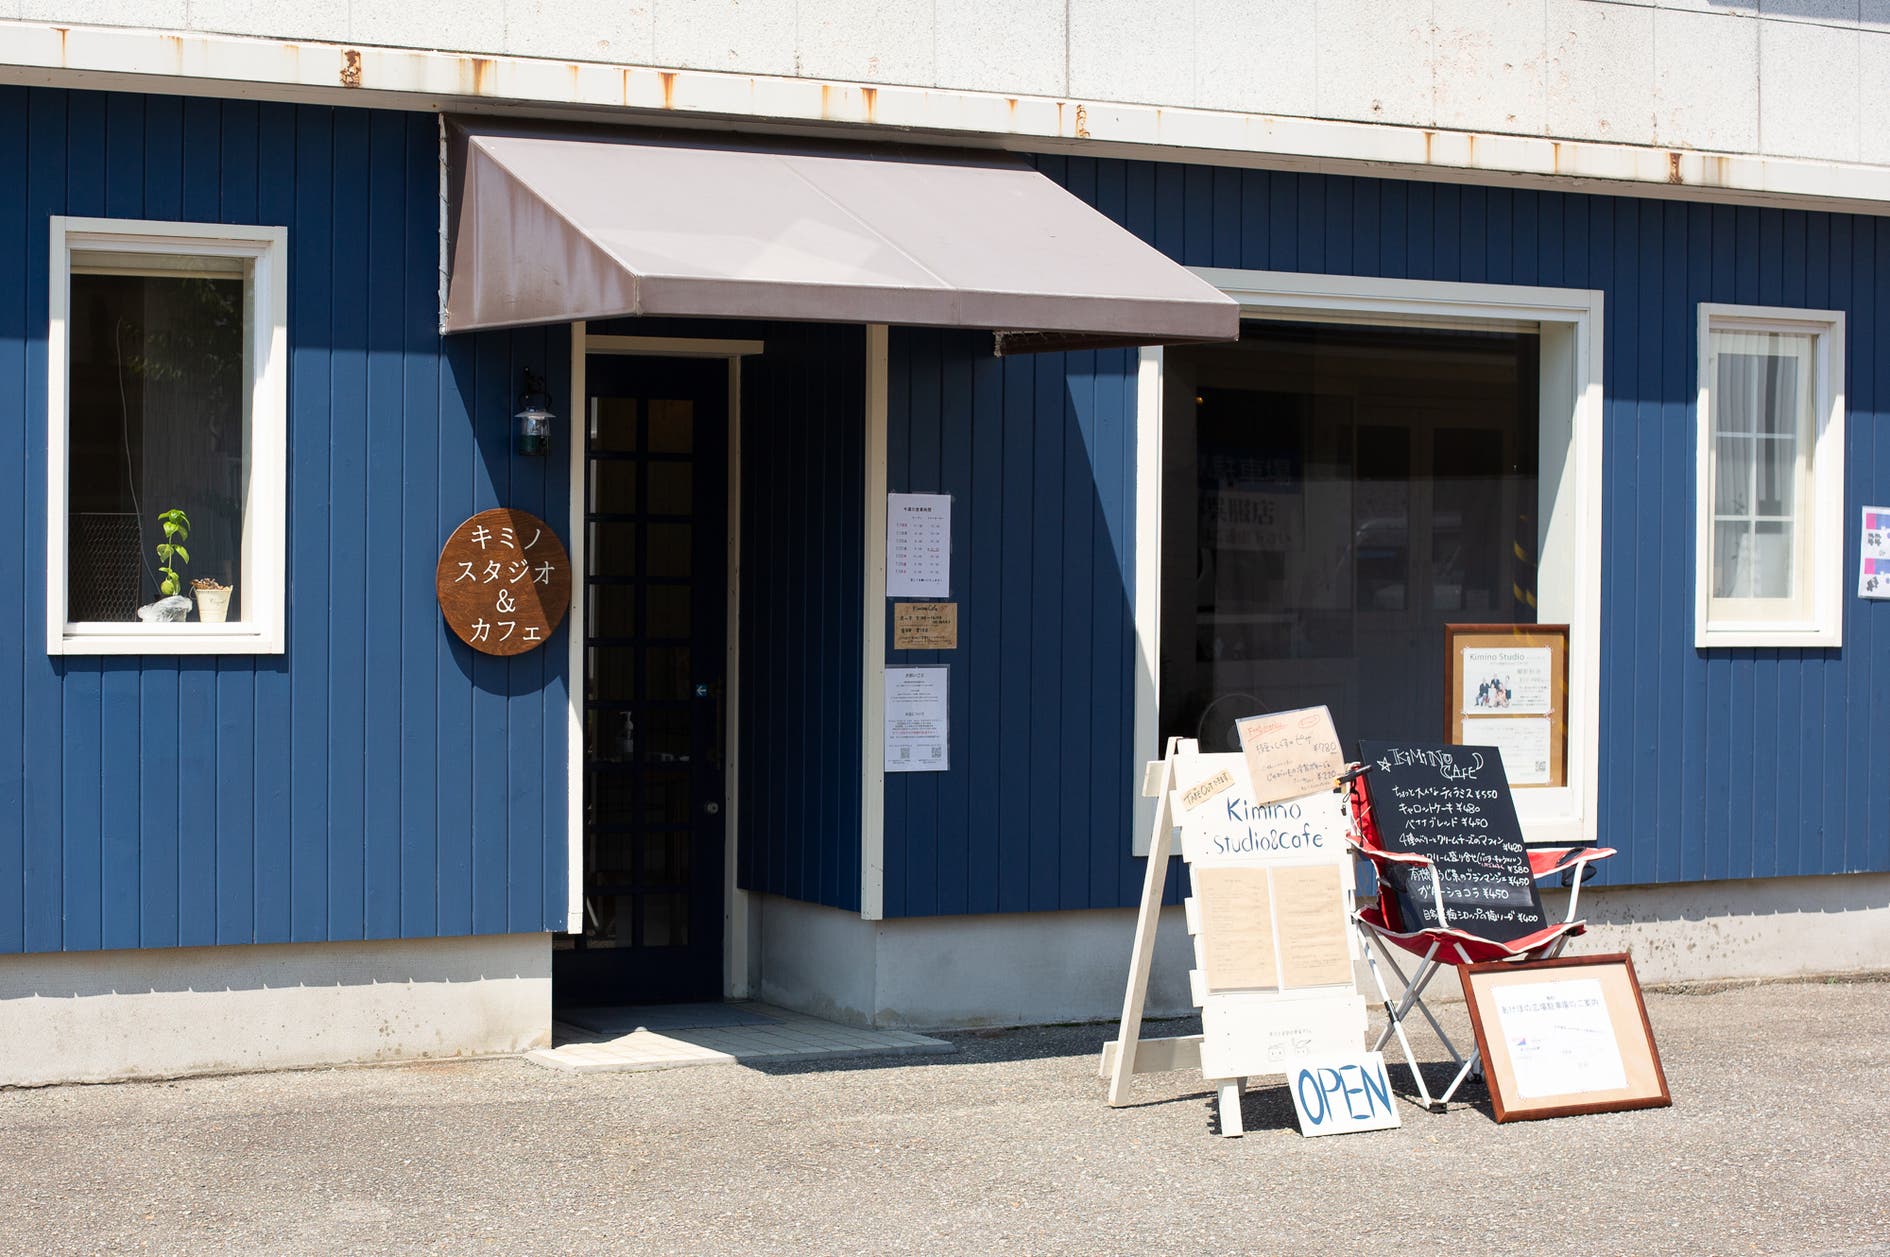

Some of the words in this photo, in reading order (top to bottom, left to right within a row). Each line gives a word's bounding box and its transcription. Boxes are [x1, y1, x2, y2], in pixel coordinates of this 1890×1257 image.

[471, 525, 541, 550] キミノ
[455, 559, 555, 585] スタジオ
[496, 589, 516, 613] &
[470, 617, 541, 643] カフェ
[1469, 652, 1498, 662] Kimino
[1499, 652, 1525, 662] Studio
[1440, 764, 1477, 781] CAFE
[1475, 790, 1498, 800] ¥550
[1227, 797, 1302, 822] Kimino
[1456, 802, 1481, 815] ¥480
[1461, 817, 1489, 829] ¥450
[1408, 867, 1507, 883] 有機うじ茶のブランマンジェ
[1507, 875, 1530, 887] ¥450
[1483, 887, 1509, 900] ¥450
[1423, 907, 1516, 922] 自家梅シロップの梅ソーダ
[1517, 912, 1539, 923] ¥400
[1297, 1060, 1393, 1126] OPEN
